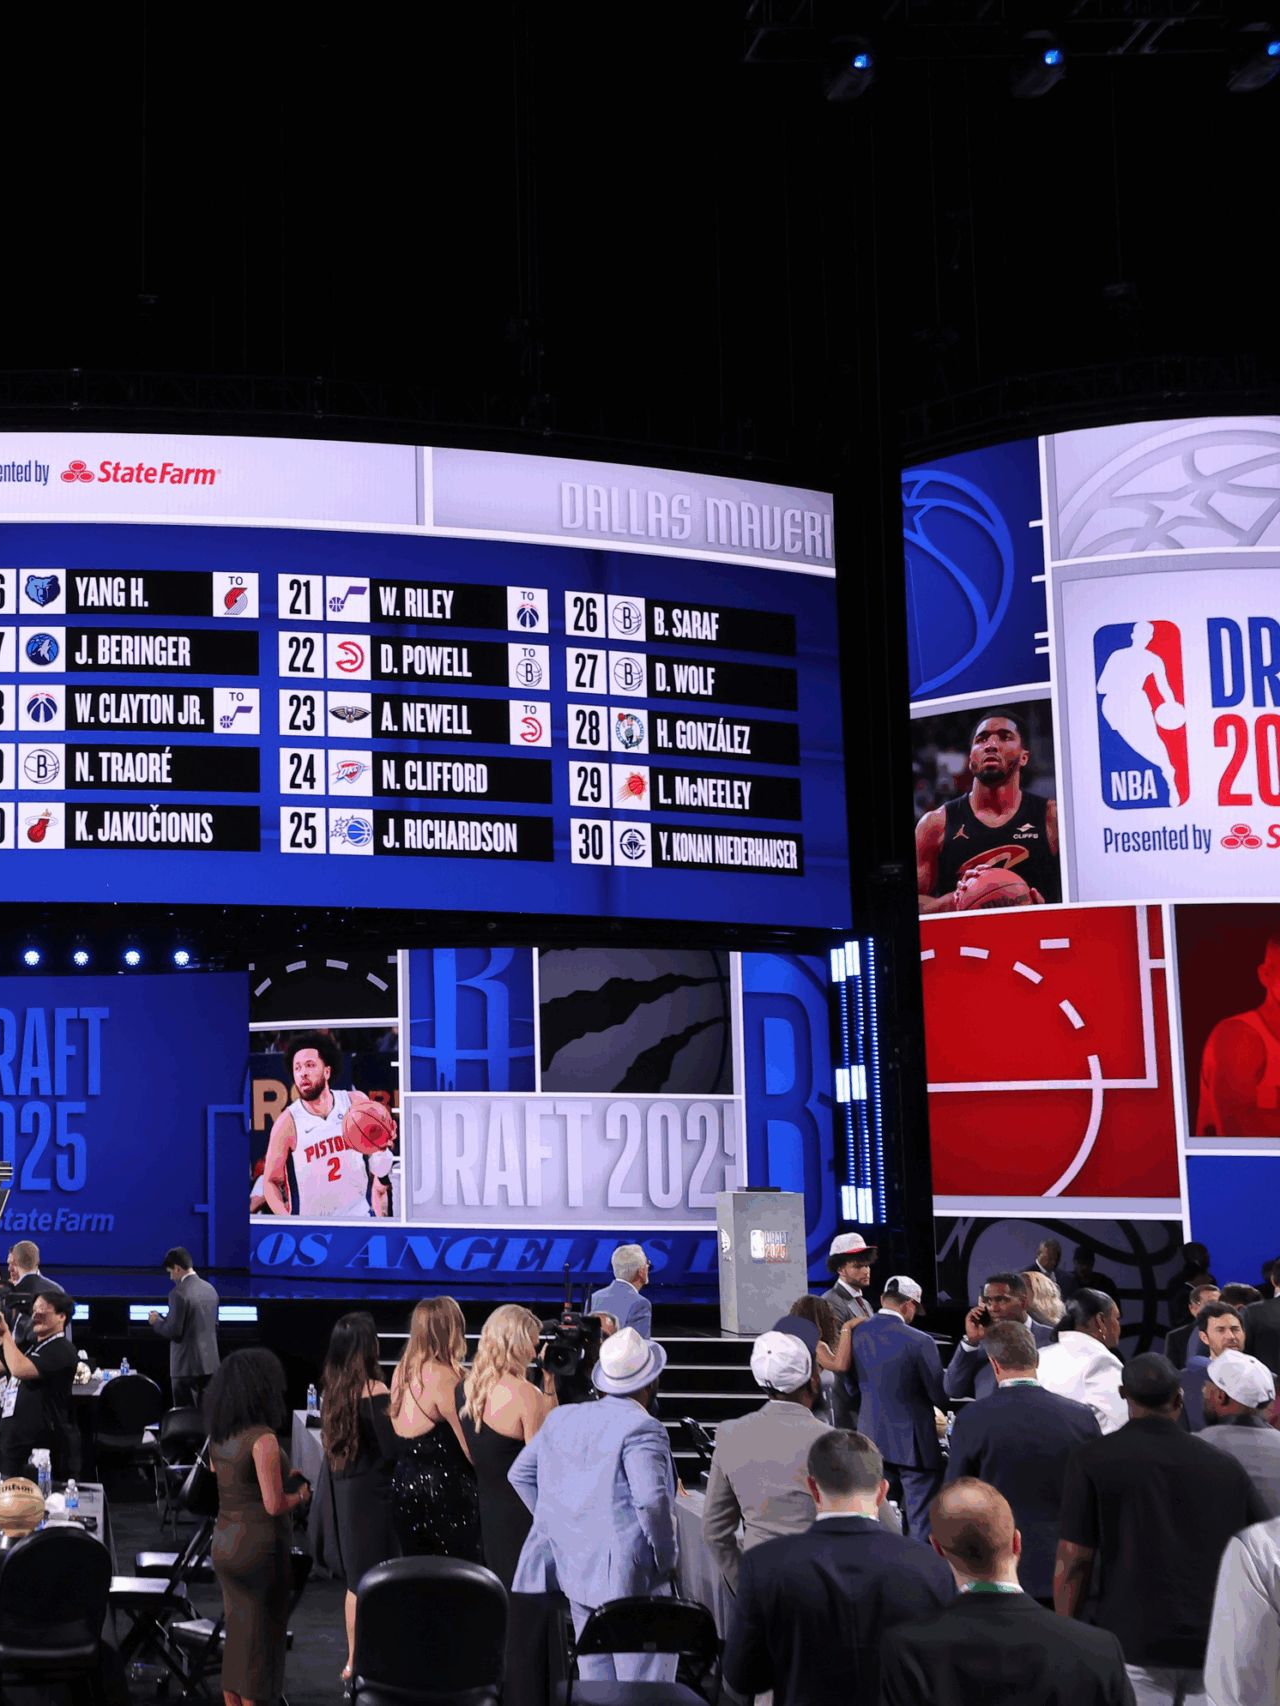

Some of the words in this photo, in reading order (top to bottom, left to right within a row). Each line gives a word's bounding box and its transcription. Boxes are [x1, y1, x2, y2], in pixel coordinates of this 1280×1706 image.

[35, 461, 50, 486] by
[560, 481, 692, 540] DALLAS
[76, 577, 125, 606] YANG
[131, 578, 148, 607] H.
[228, 576, 243, 585] TO
[290, 579, 310, 614] 21
[379, 587, 400, 616] W.
[405, 588, 454, 619] RILEY
[522, 592, 534, 600] TO
[574, 597, 597, 632] 26
[654, 607, 668, 636] B.
[672, 609, 719, 640] SARAF
[75, 635, 92, 664] J.
[98, 635, 190, 666] BERINGER
[289, 637, 314, 672] 22
[381, 644, 397, 673] D.
[403, 645, 472, 677] POWELL
[522, 648, 535, 657] TO
[576, 653, 598, 688] 27
[656, 663, 670, 691] D.
[673, 664, 715, 695] WOLF
[75, 693, 94, 722] W.
[99, 693, 173, 724] CLAYTON
[178, 695, 204, 724] JR.
[230, 692, 244, 701] TO
[289, 695, 314, 731] 23
[381, 702, 398, 731] A.
[403, 703, 472, 734] NEWELL
[523, 705, 536, 714] TO
[576, 710, 599, 745] 28
[657, 719, 672, 747] H.
[676, 718, 751, 754] GONZÁLEZ
[76, 752, 94, 781] N.
[99, 747, 172, 782] TRAORÉ
[290, 753, 315, 789] 24
[383, 760, 400, 789] N.
[405, 760, 487, 793] CLIFFORD
[578, 767, 601, 802] 29
[659, 775, 671, 804] L.
[675, 776, 751, 809] McNEELEY
[1111, 769, 1157, 801] NBA
[76, 811, 93, 841] K.
[98, 804, 213, 843] JAKUČIONIS
[290, 812, 316, 848] 25
[383, 819, 399, 848] J.
[405, 819, 517, 852] RICHARDSON
[1104, 824, 1188, 853] Presented
[1193, 823, 1212, 854] by
[579, 824, 602, 859] 30
[659, 832, 670, 860] Y.
[673, 833, 712, 863] KONAN
[715, 835, 797, 869] NIEDERHAUSER
[304, 1135, 354, 1163] PISTO
[412, 1101, 592, 1207] DRAFT
[327, 1157, 341, 1182] 2
[250, 1232, 333, 1267] OS
